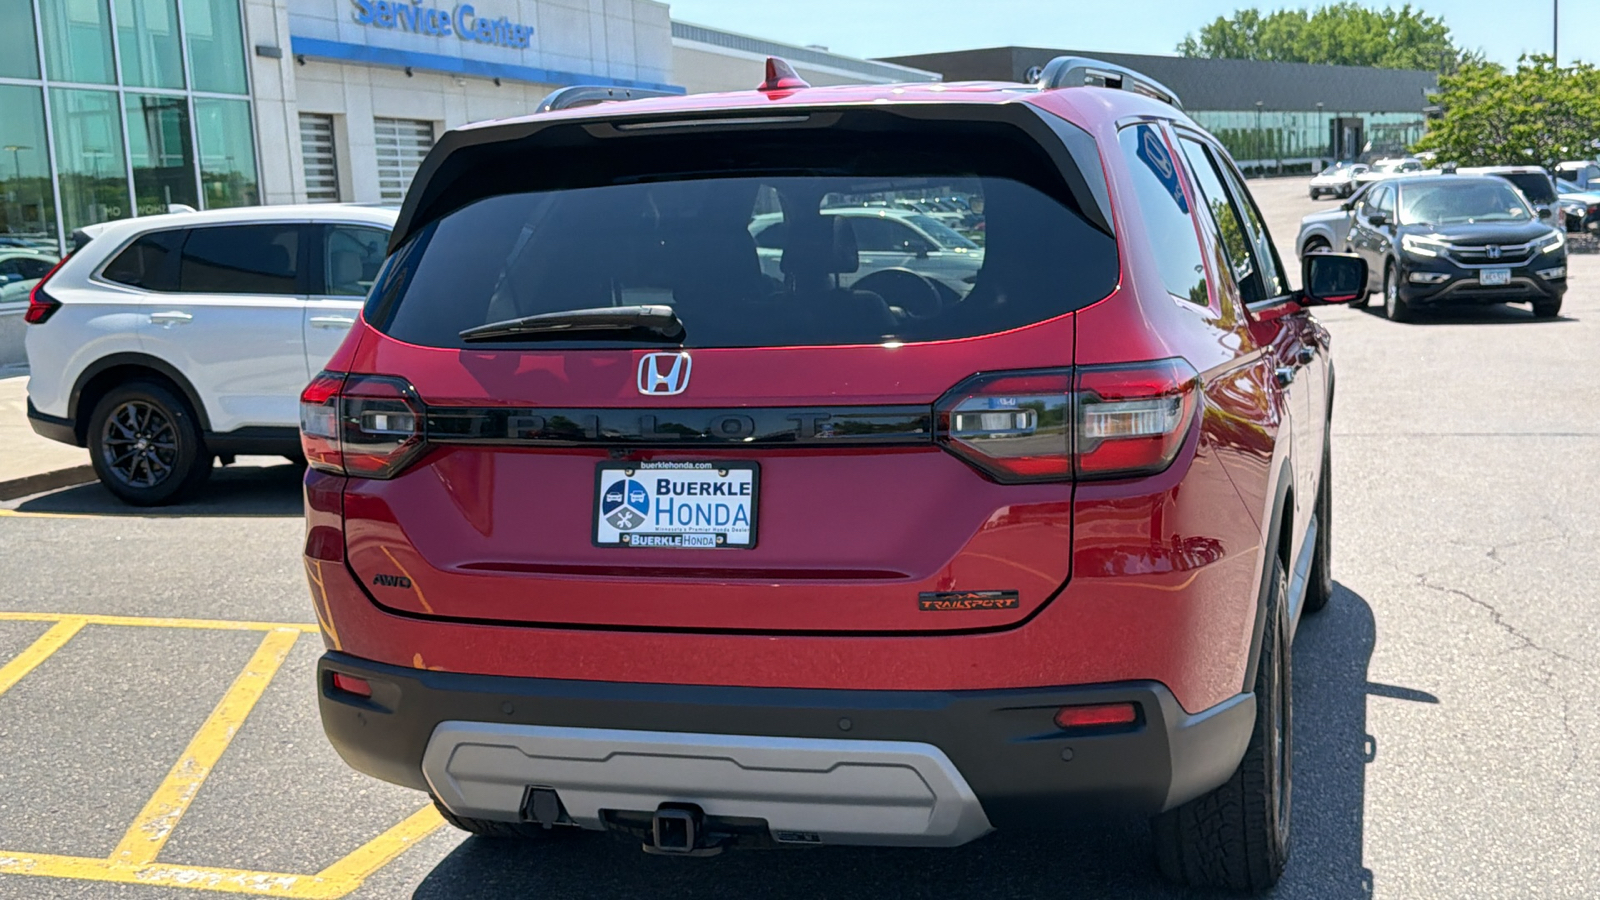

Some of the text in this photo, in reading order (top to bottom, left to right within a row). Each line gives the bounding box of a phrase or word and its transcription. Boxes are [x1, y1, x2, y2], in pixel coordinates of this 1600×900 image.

[353, 0, 534, 49] Service Center
[507, 412, 831, 439] PILOT
[656, 478, 751, 496] BUERKLE
[655, 497, 749, 526] HONDA
[631, 534, 714, 546] BUERKLE HONDA
[373, 573, 412, 589] AWD
[921, 599, 1015, 610] TRAILSPORT
